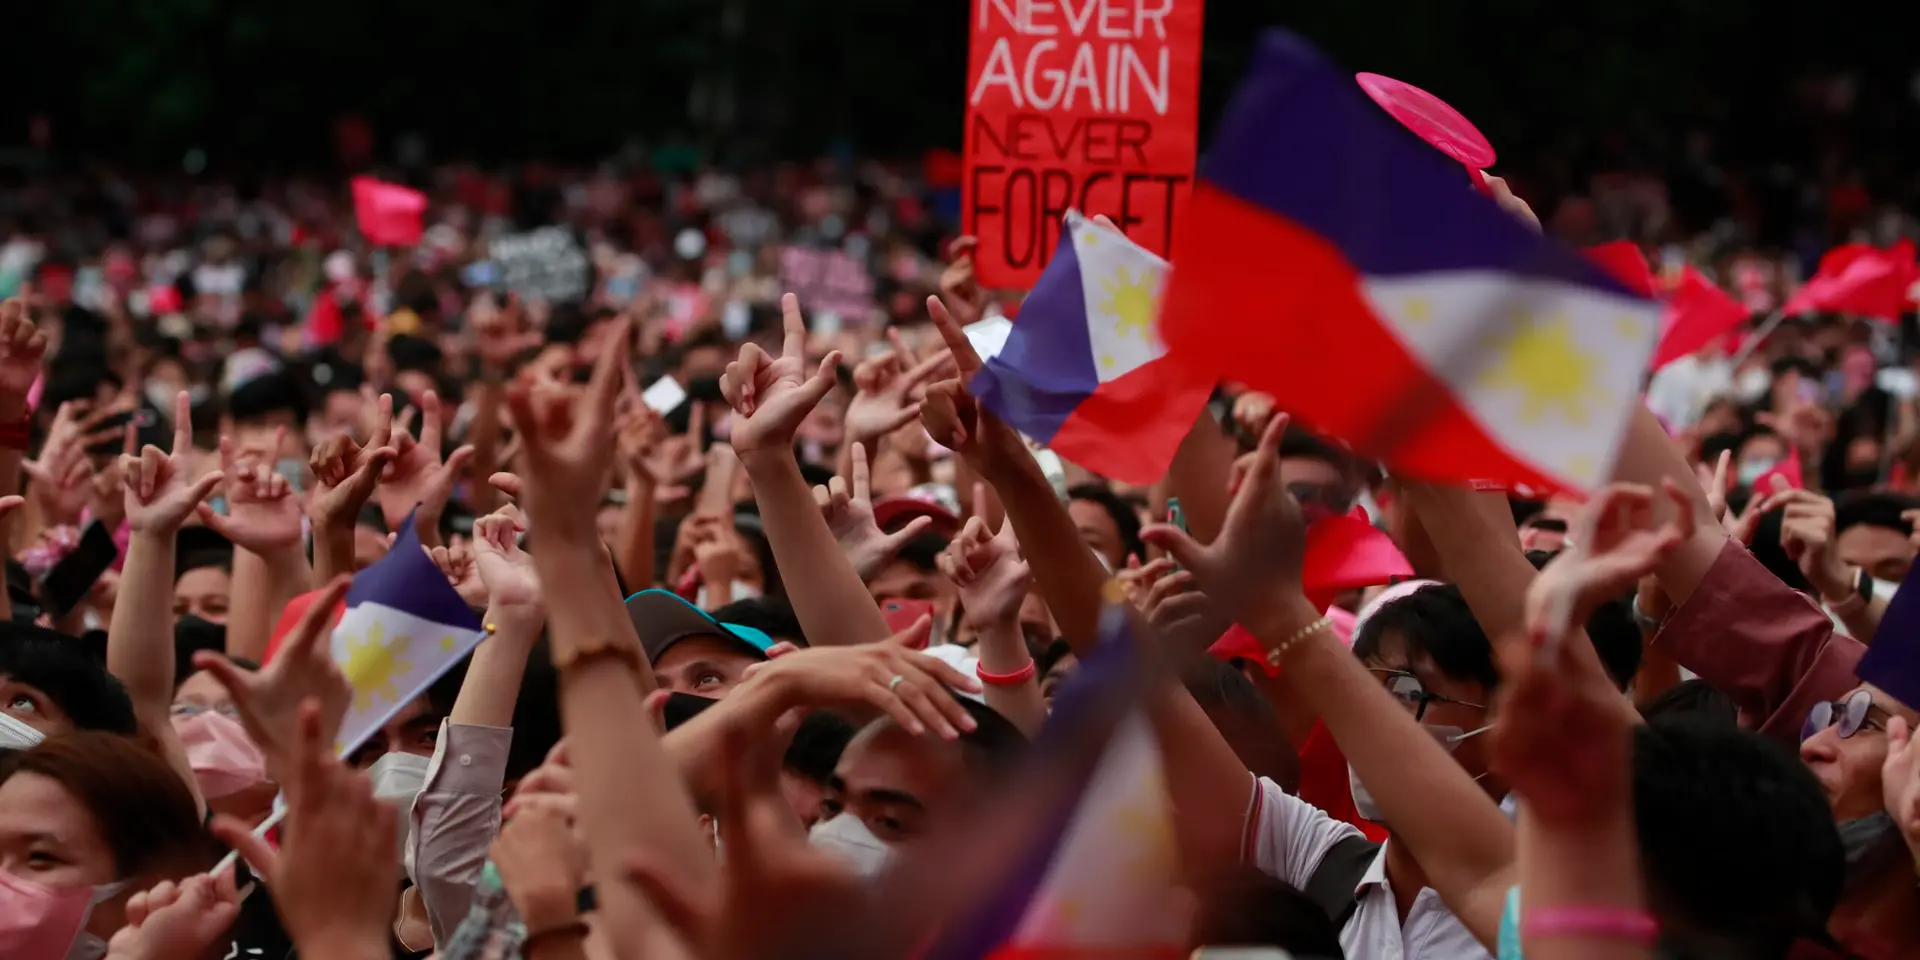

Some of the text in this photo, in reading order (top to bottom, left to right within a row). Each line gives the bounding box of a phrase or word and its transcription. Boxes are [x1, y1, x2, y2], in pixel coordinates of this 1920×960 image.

[978, 0, 1173, 40] NEVER
[970, 37, 1169, 116] AGAIN
[973, 113, 1152, 166] NEVER
